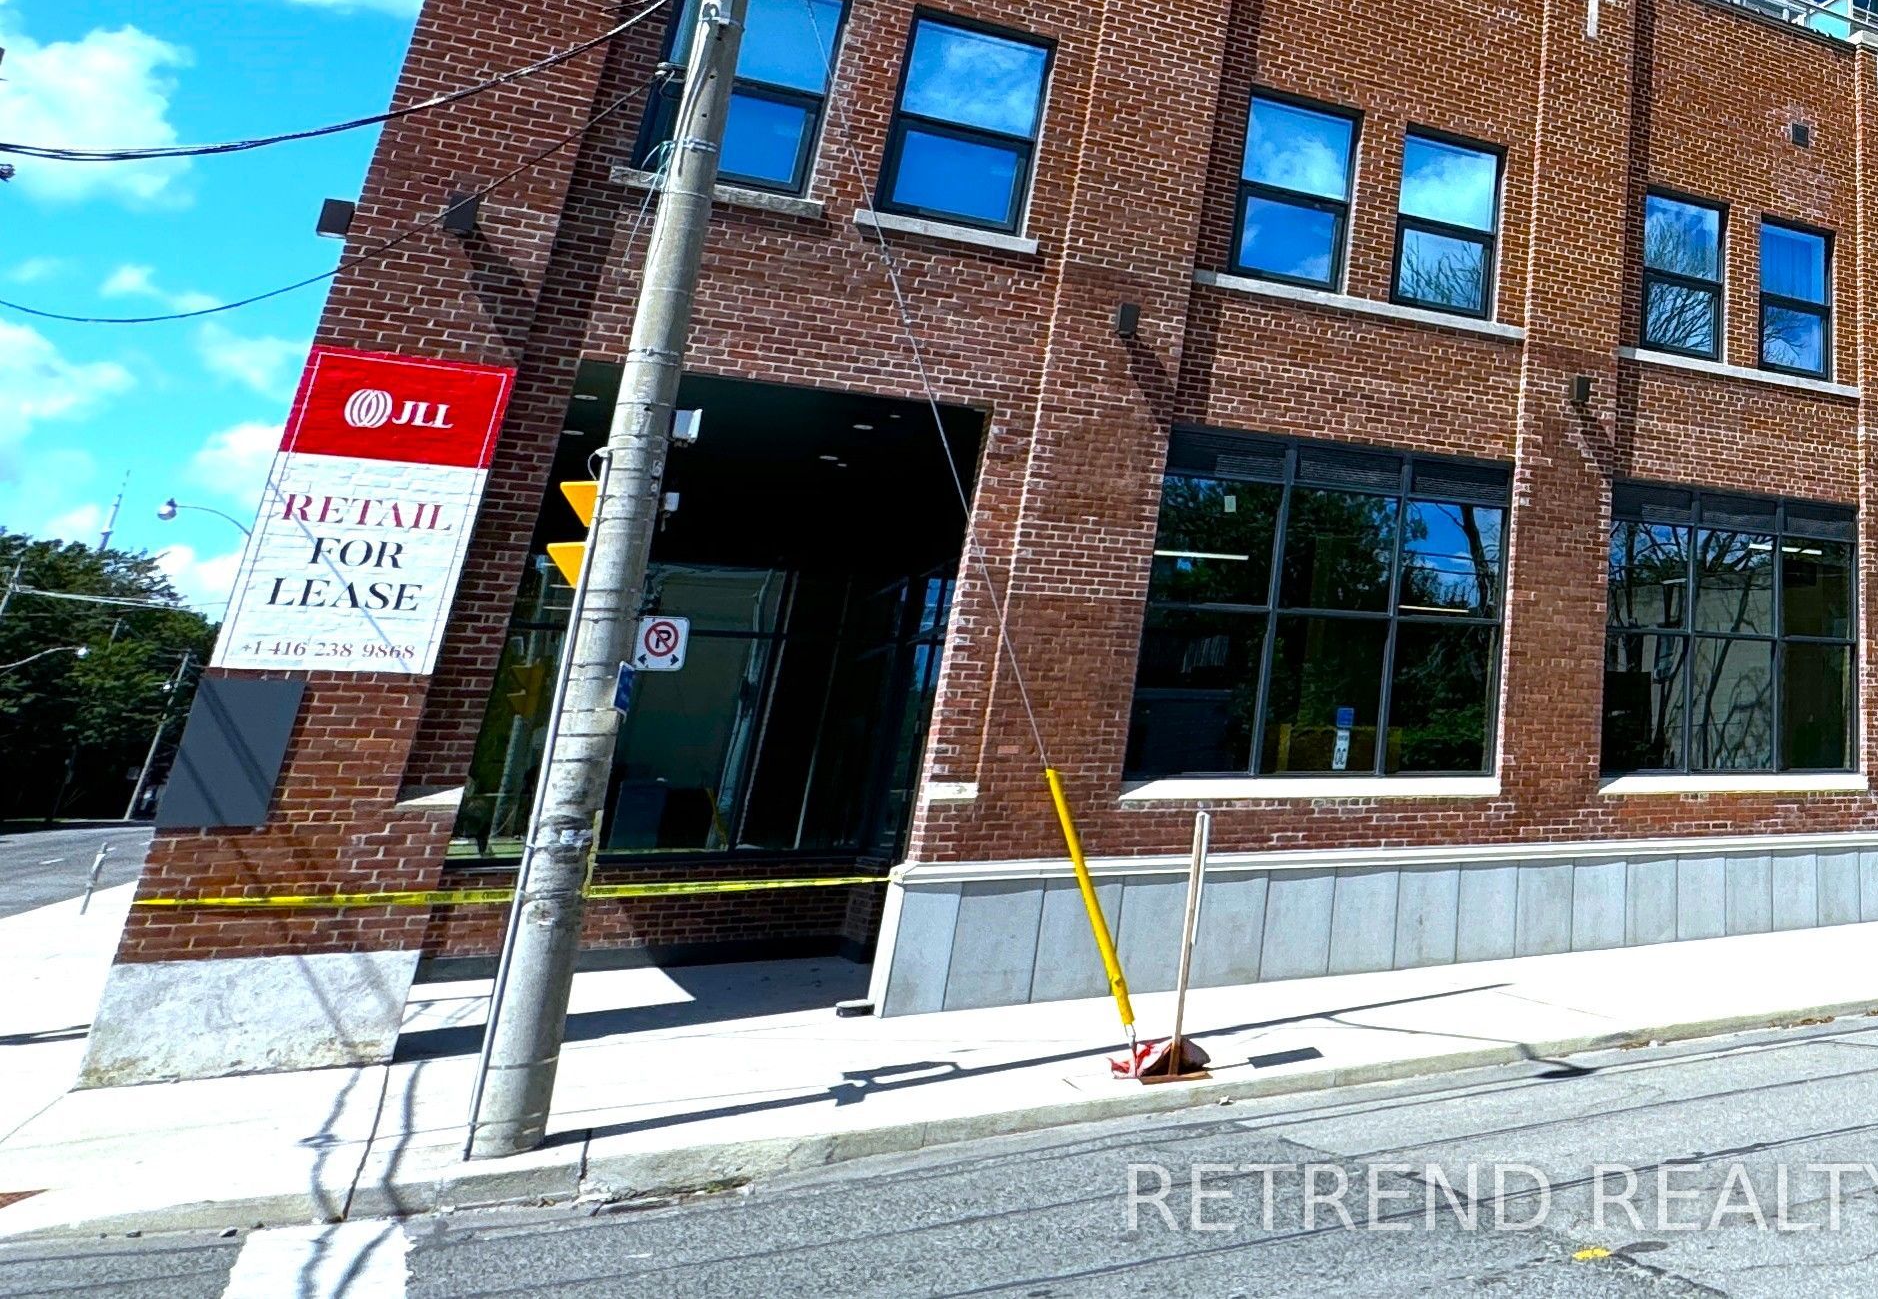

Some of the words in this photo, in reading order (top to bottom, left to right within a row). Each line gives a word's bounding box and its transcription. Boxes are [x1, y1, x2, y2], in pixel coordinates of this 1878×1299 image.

[391, 400, 454, 429] JLL
[281, 493, 452, 531] RETAIL
[307, 536, 404, 569] FOR
[266, 577, 423, 612] LEASE
[267, 640, 307, 657] 416
[313, 641, 353, 658] 238
[361, 643, 415, 661] 9868
